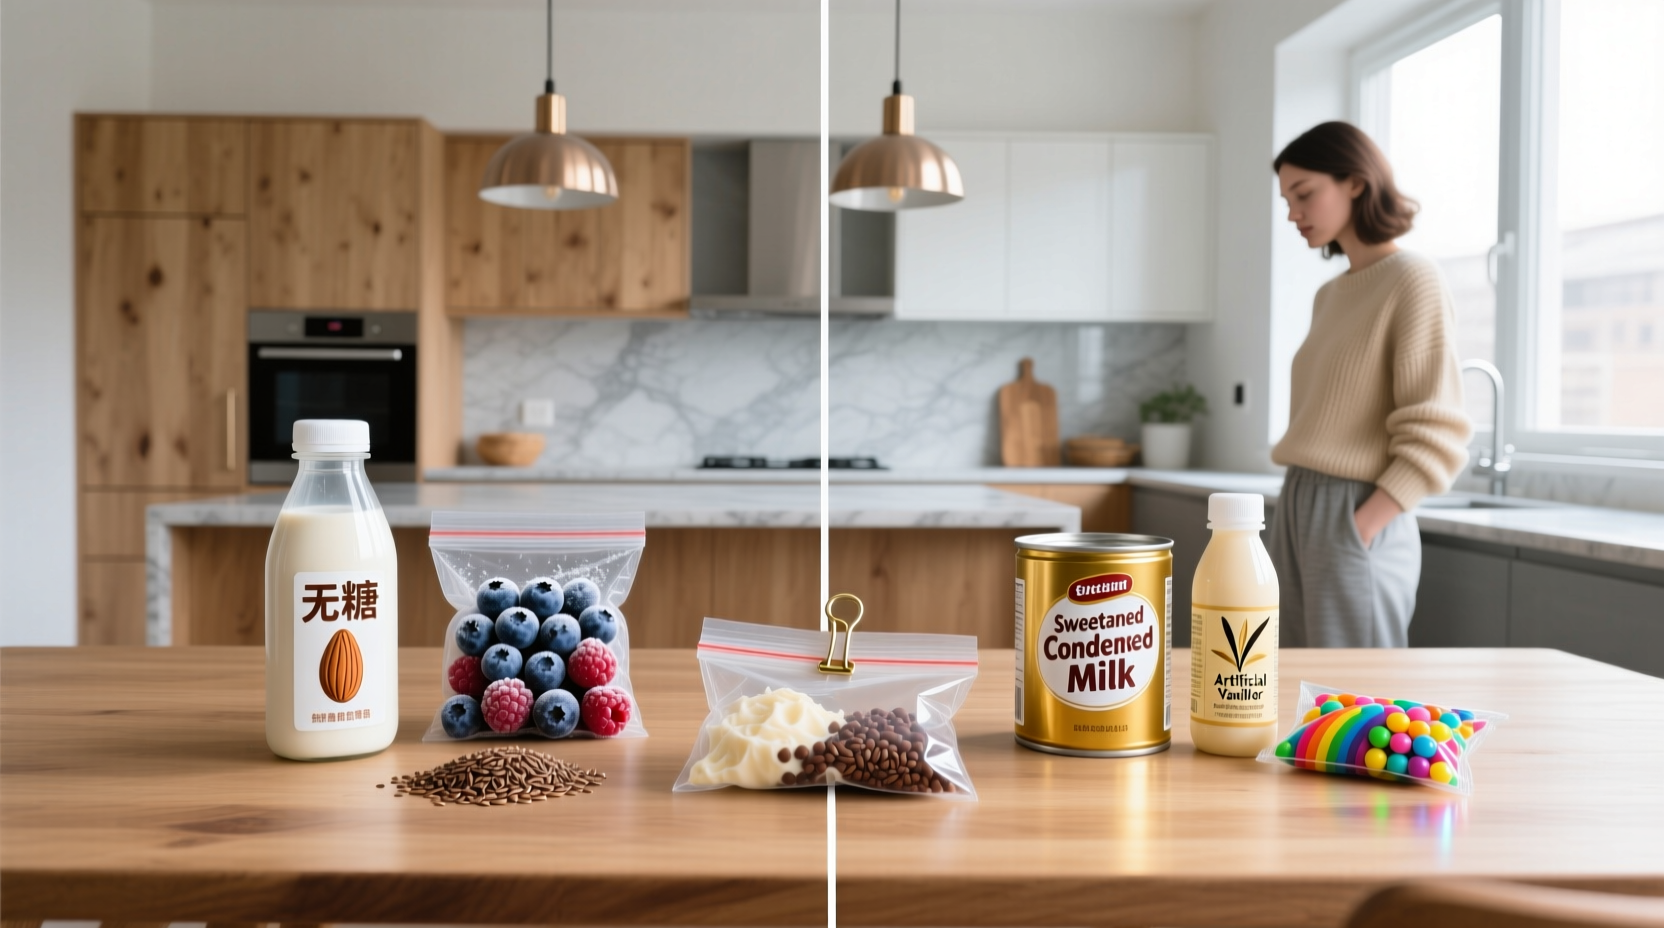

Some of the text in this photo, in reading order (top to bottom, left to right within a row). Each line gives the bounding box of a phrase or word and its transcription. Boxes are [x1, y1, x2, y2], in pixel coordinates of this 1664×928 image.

[302, 580, 379, 623] 无糖
[1054, 605, 1144, 633] Sweetaned
[1067, 658, 1136, 693] Milk
